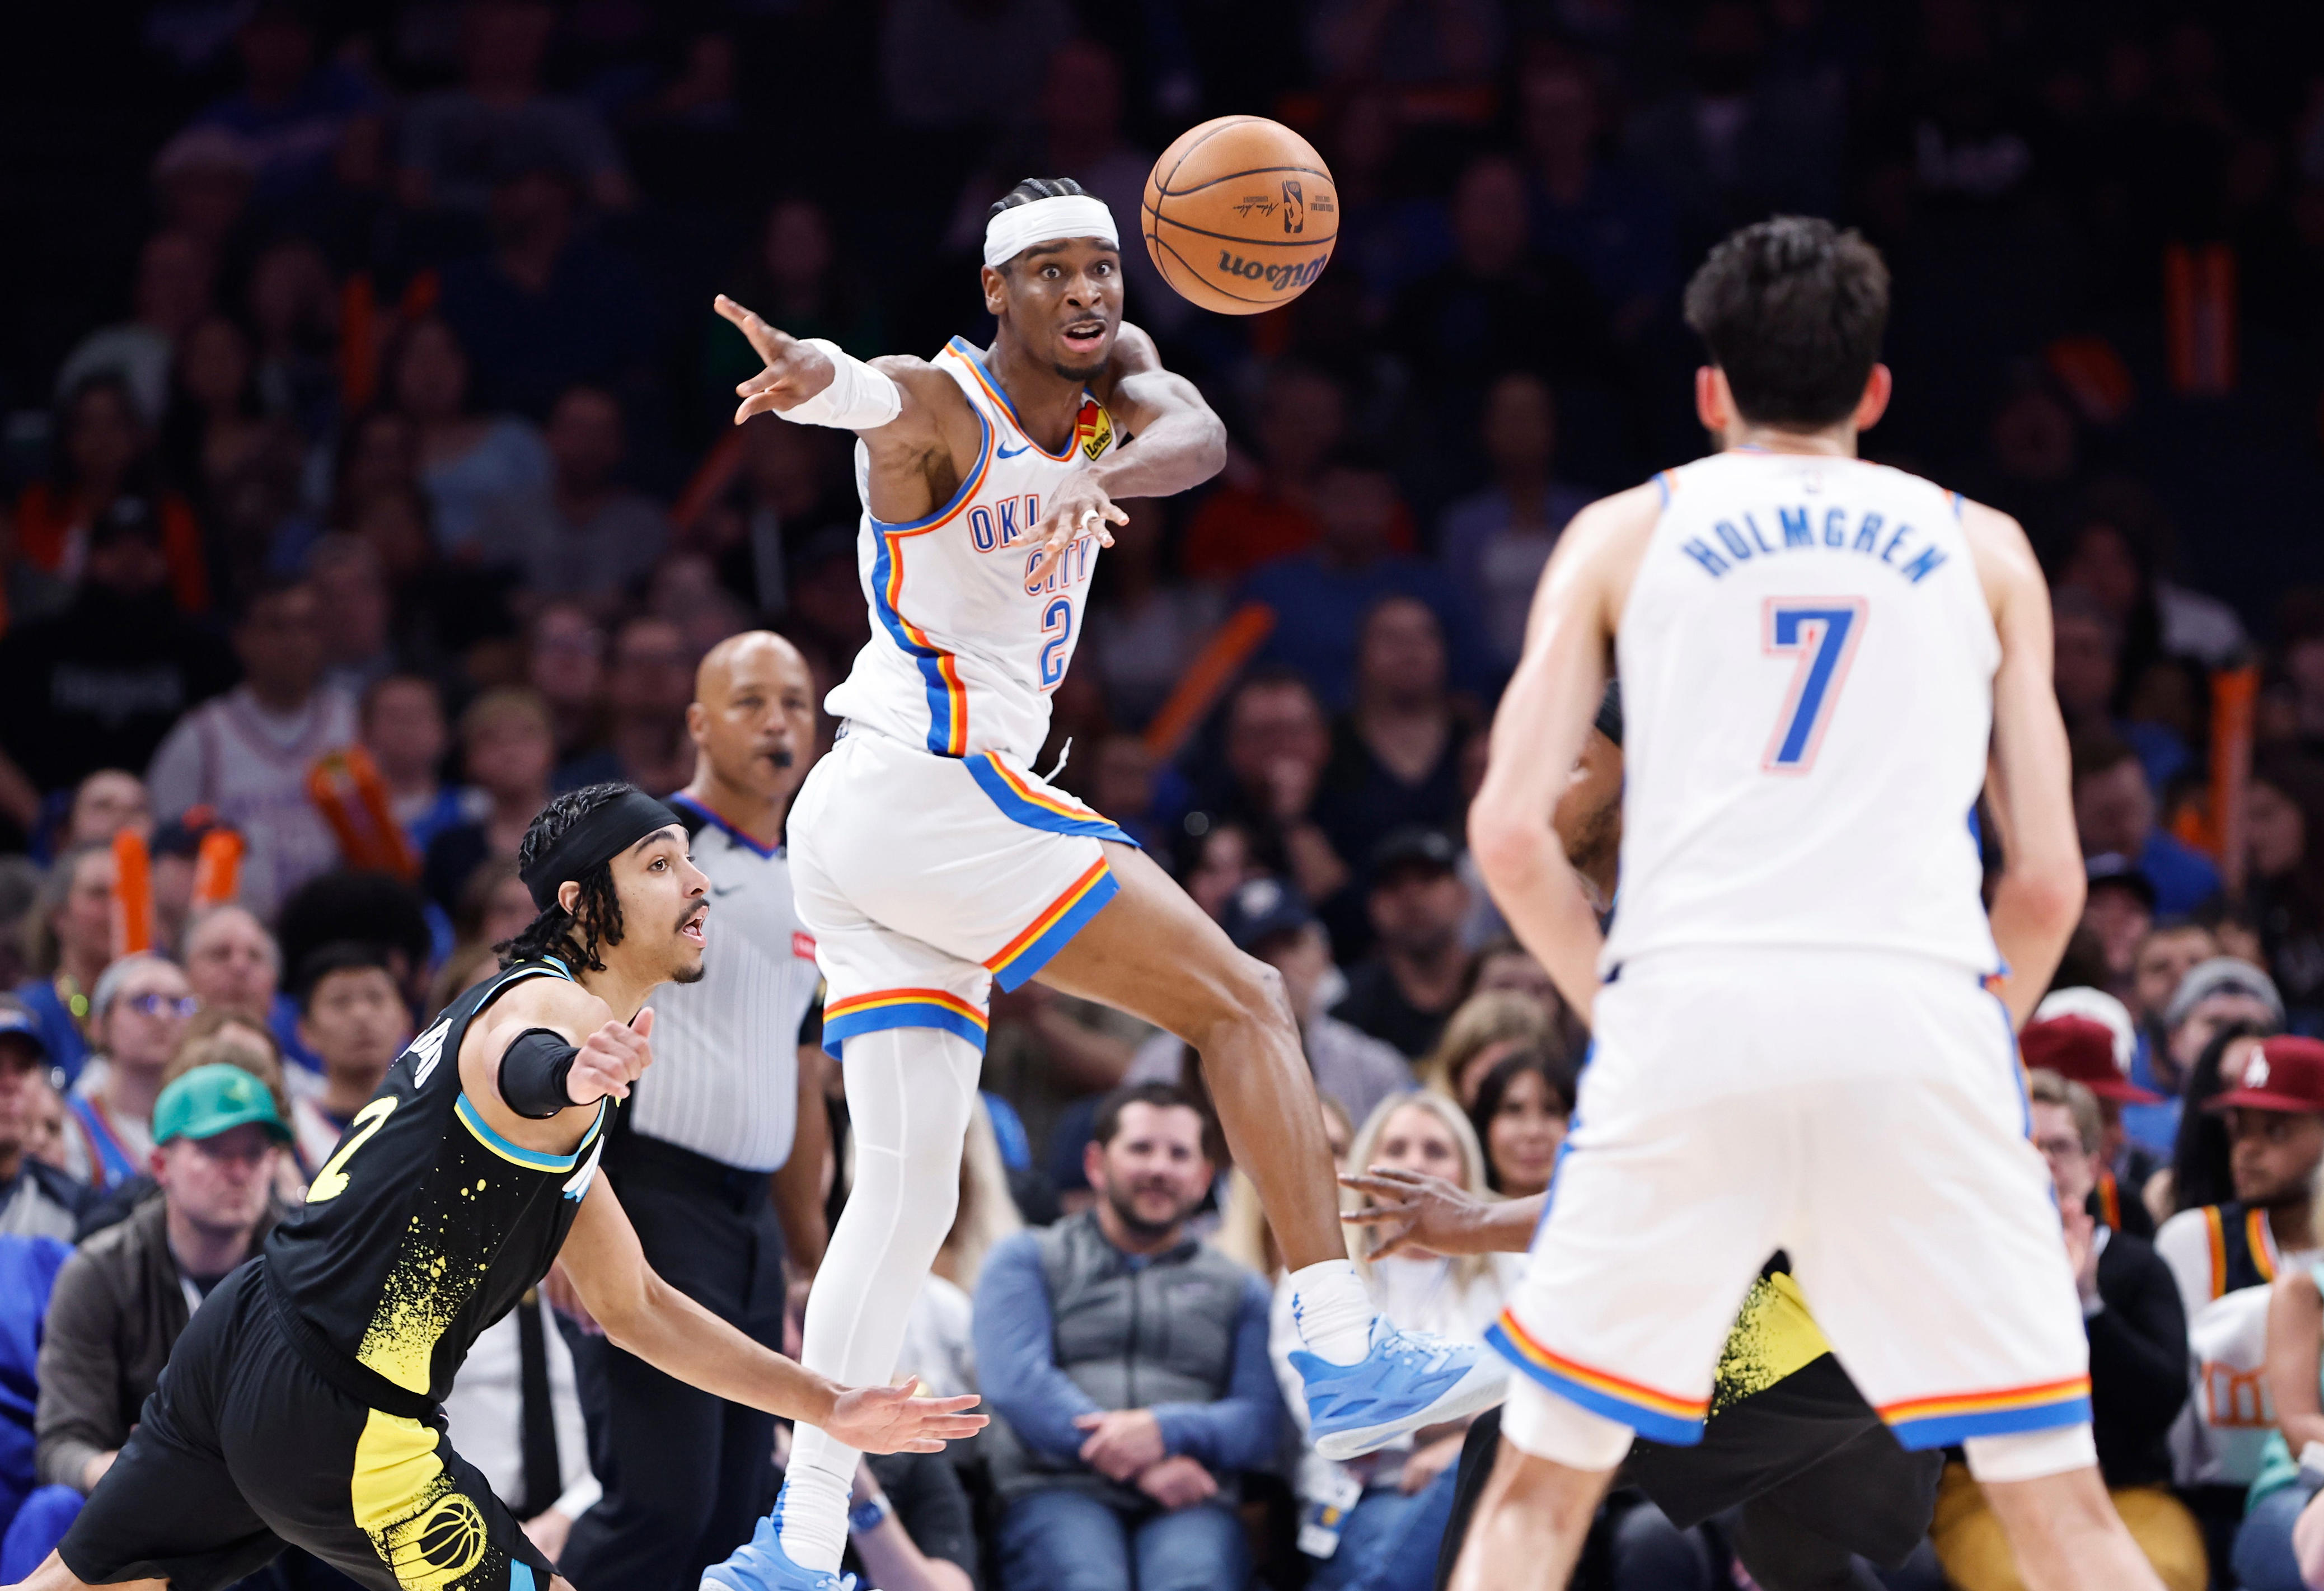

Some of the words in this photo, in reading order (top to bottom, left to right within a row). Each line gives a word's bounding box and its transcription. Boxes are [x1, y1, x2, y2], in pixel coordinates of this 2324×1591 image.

[1217, 249, 1328, 291] Wilson
[1680, 506, 1948, 585] HOLMGREN
[1038, 595, 1075, 692] 2
[1759, 595, 1869, 777] 7
[305, 1096, 399, 1204] 2
